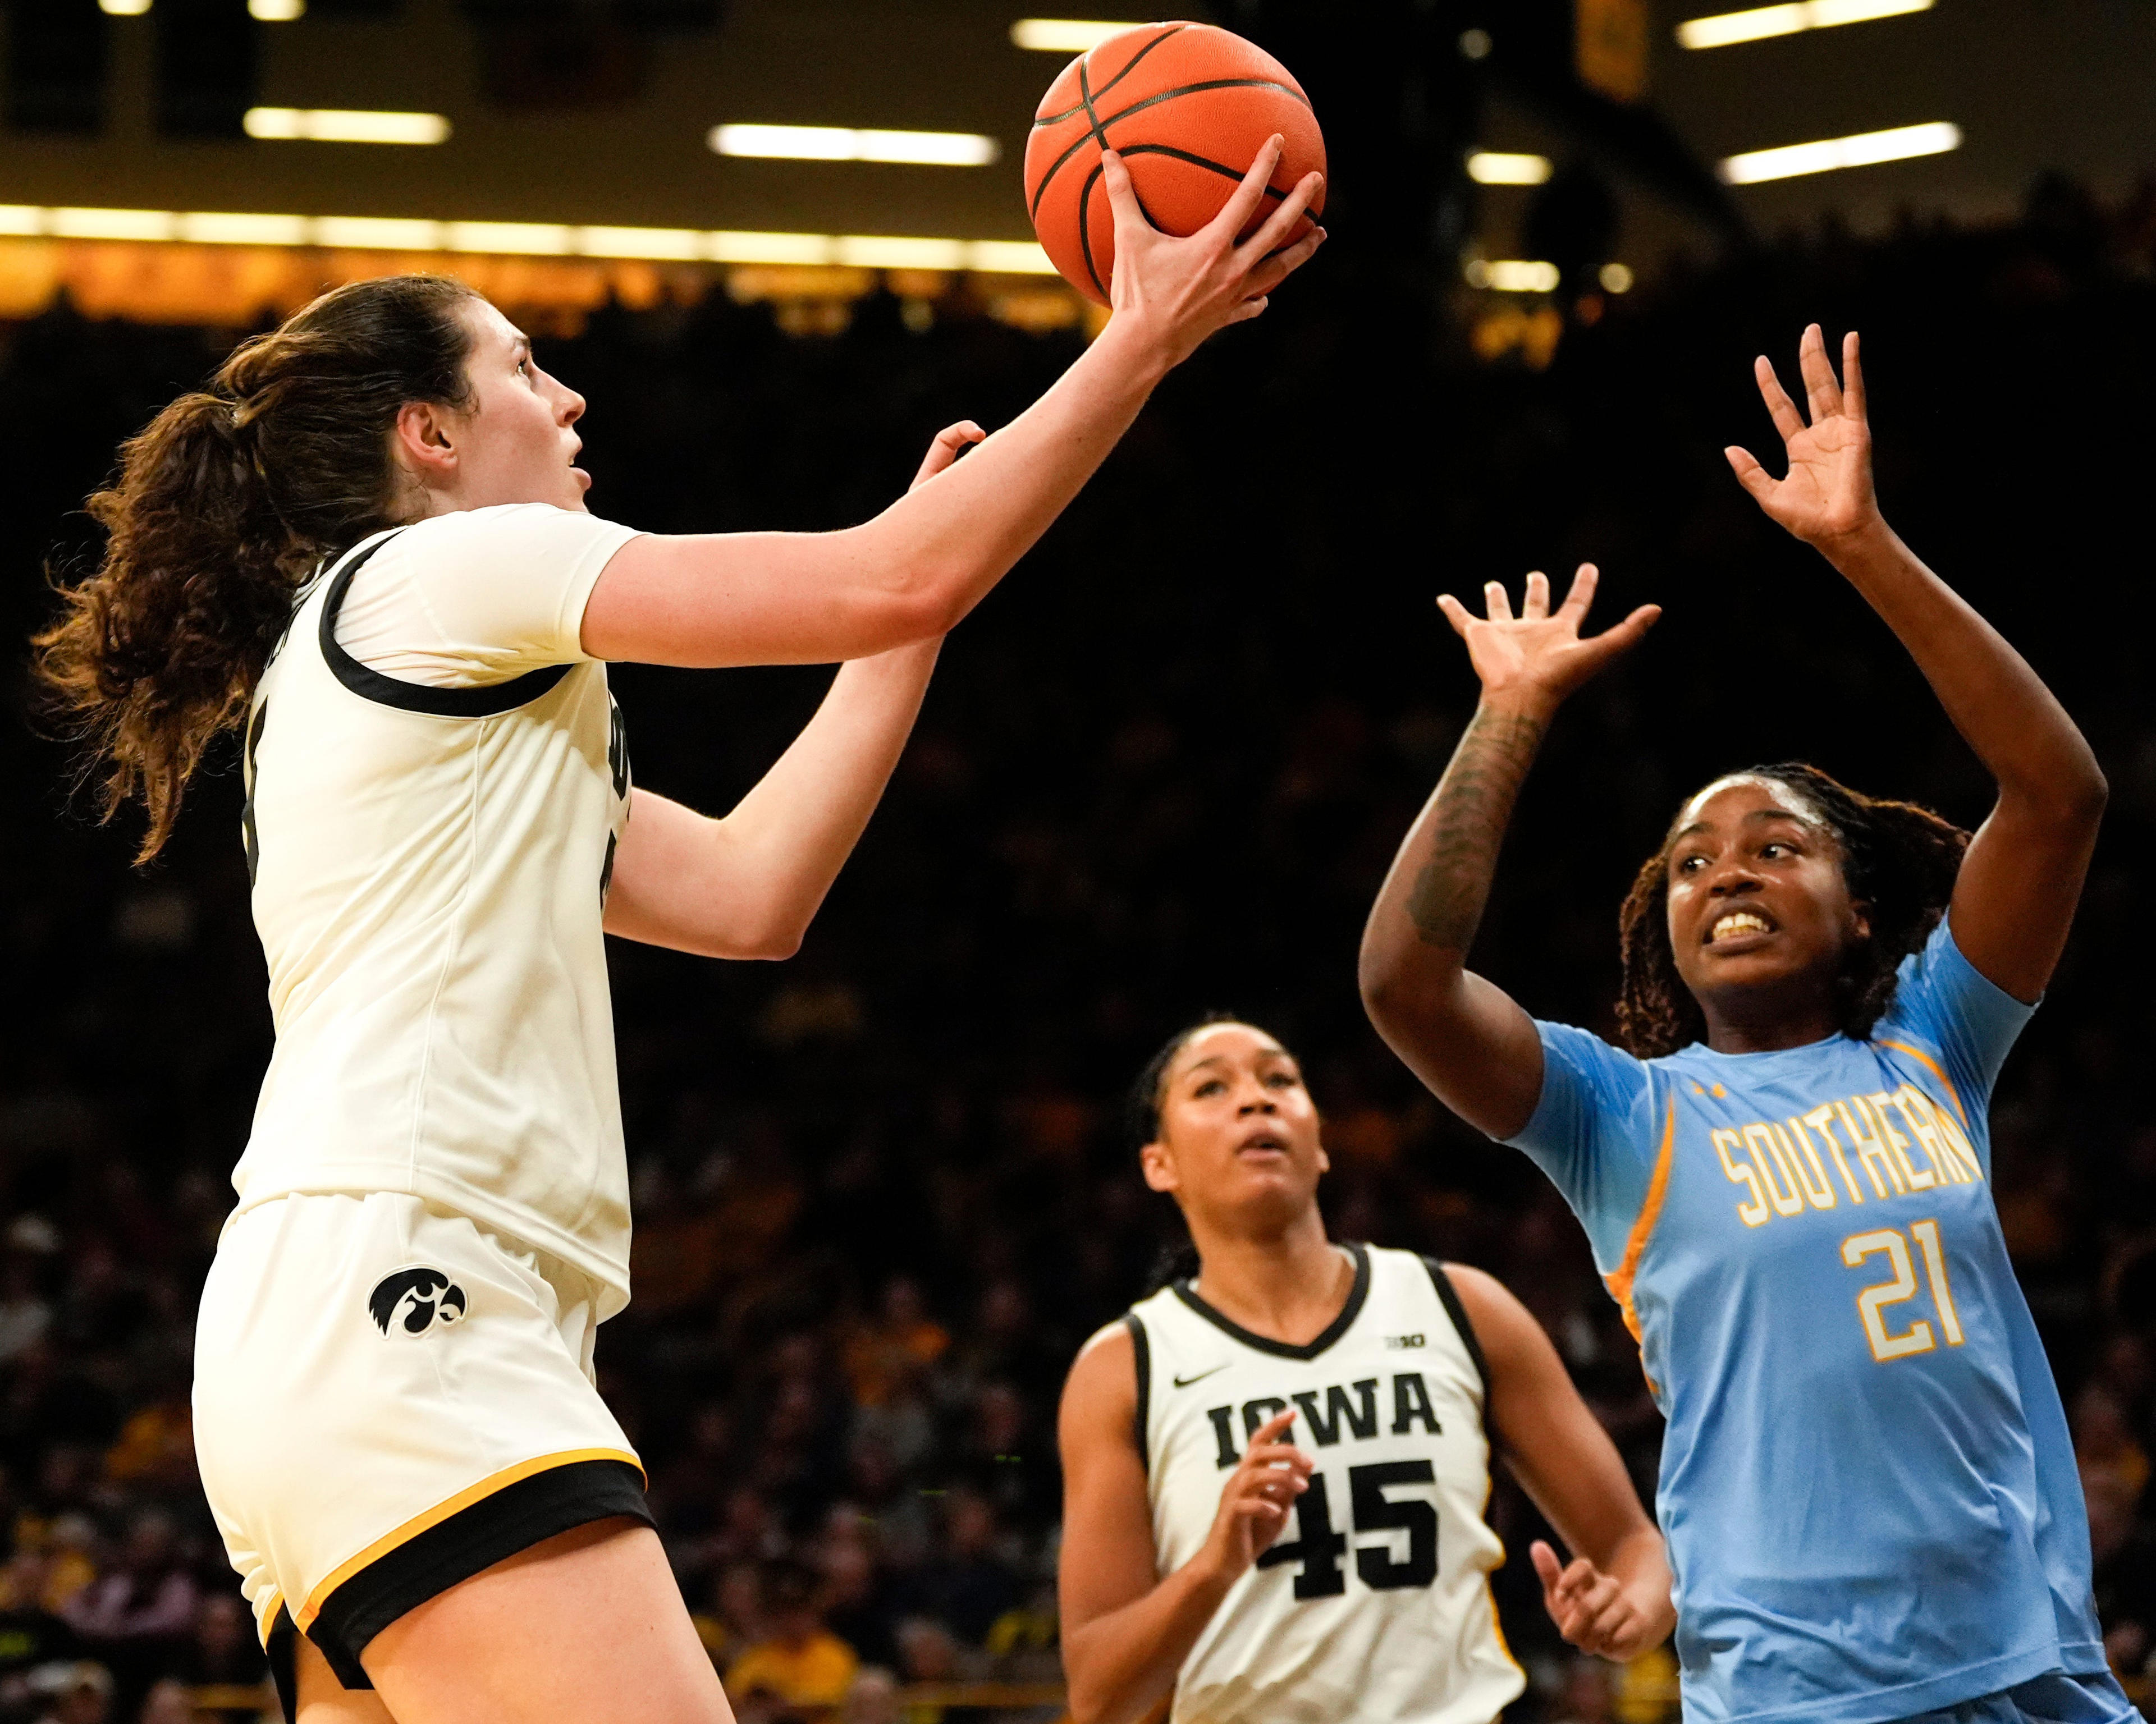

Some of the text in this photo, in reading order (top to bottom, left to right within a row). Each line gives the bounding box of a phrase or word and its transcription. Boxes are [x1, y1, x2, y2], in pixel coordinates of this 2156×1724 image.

[1711, 1084, 1985, 1228] SOUTHERN
[1841, 1219, 1965, 1363] 21
[1256, 1460, 1439, 1602] 45
